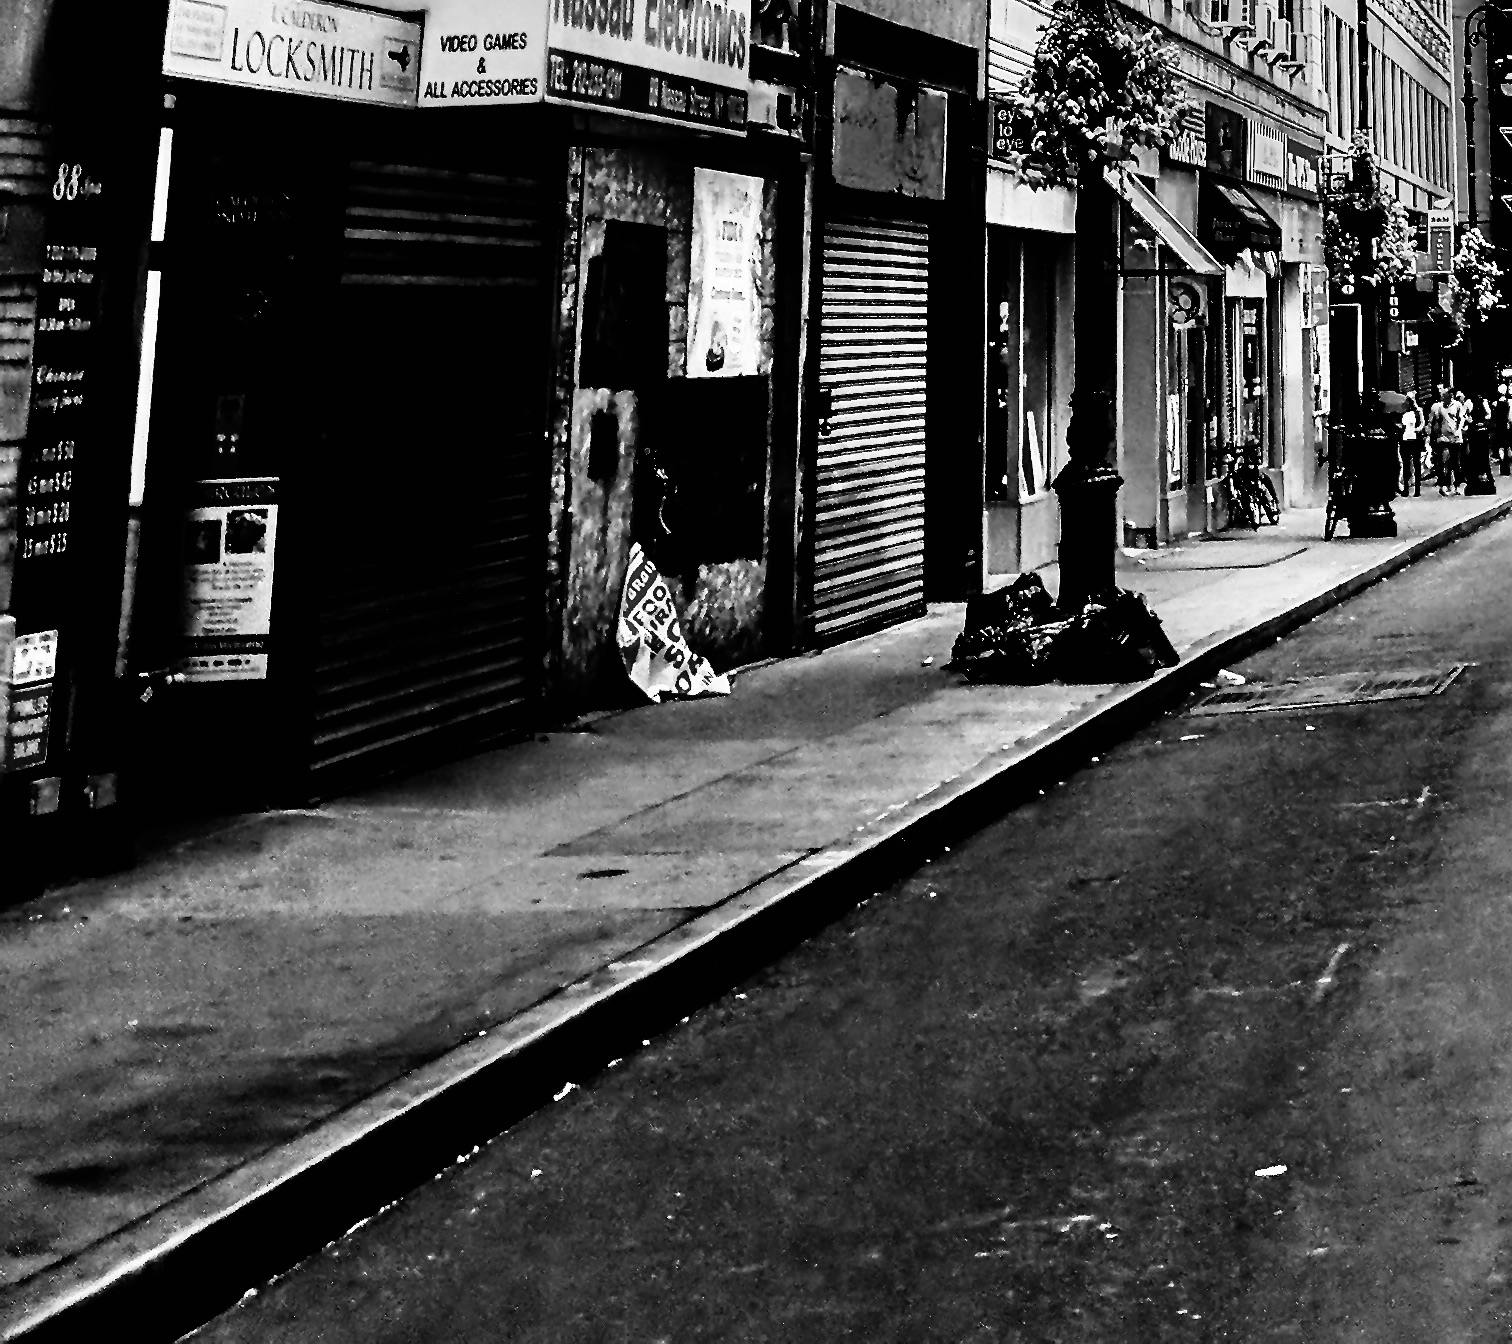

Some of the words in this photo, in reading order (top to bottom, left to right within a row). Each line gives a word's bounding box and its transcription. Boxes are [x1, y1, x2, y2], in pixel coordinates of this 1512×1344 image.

[440, 35, 478, 53] VIDEO
[483, 32, 528, 51] GAMES
[230, 26, 376, 91] LOCKSMITH
[476, 56, 487, 74] &
[424, 80, 447, 99] ALL
[451, 77, 539, 98] ACCESSORIES
